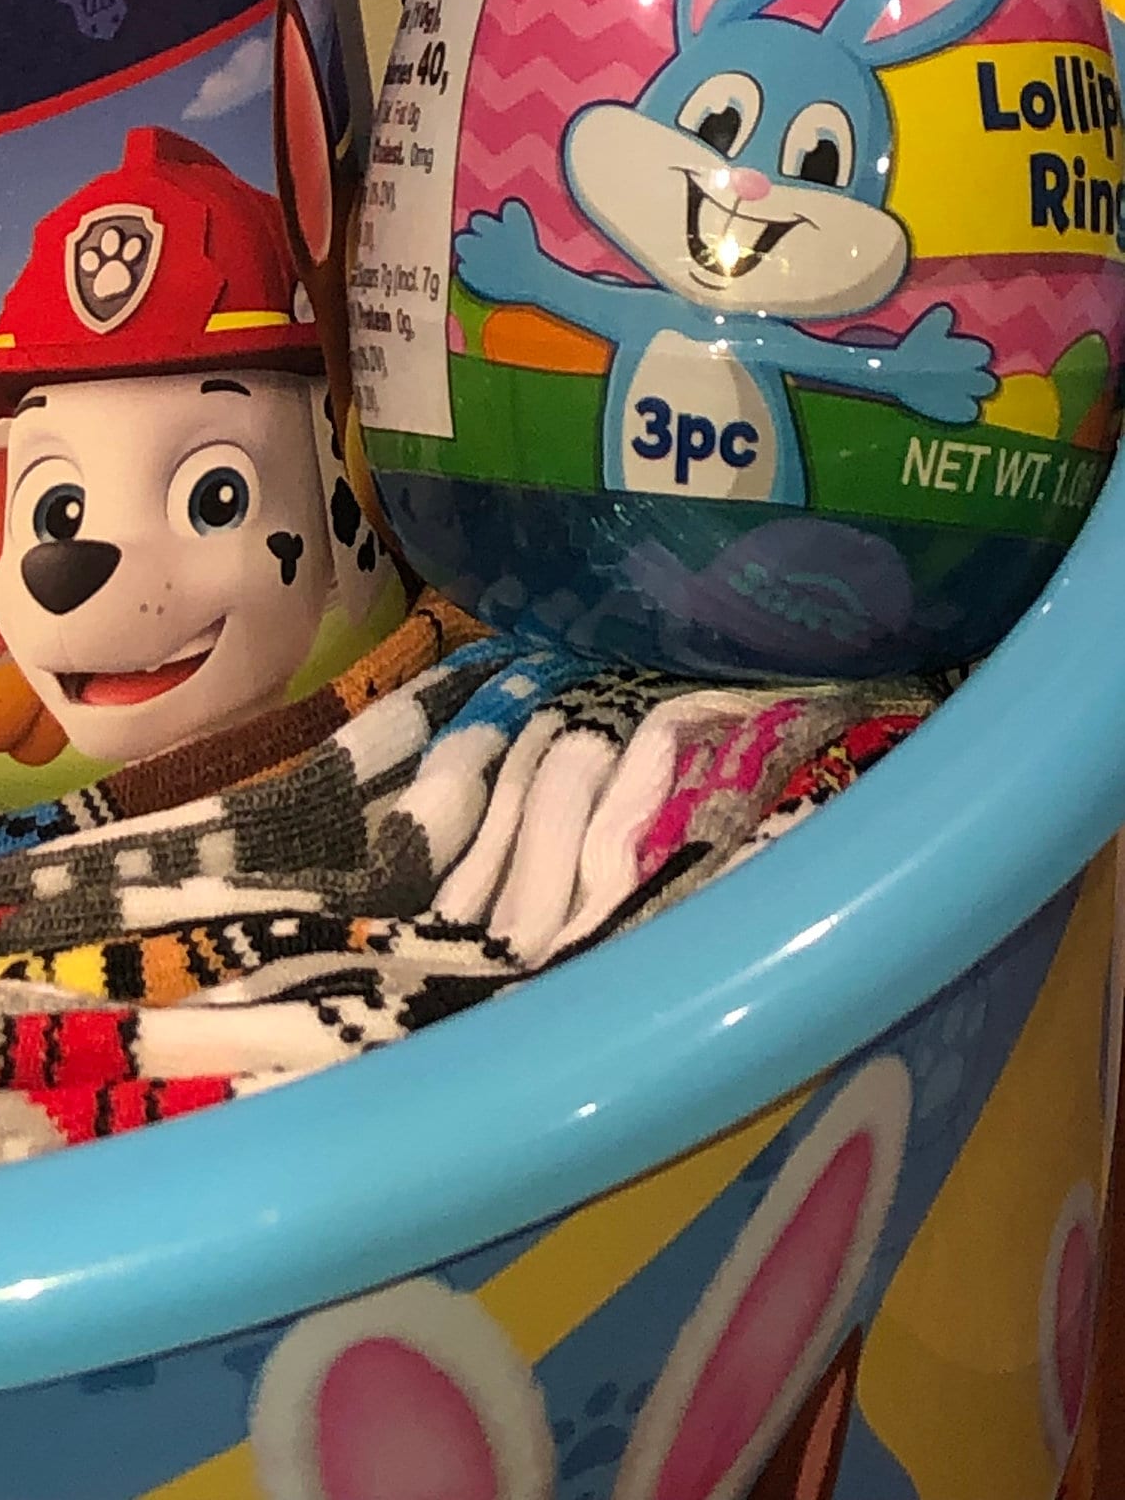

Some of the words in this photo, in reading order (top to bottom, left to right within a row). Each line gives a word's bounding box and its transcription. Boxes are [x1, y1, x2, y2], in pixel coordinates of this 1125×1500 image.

[417, 41, 449, 96] 40,
[423, 266, 441, 301] 7g
[632, 396, 759, 485] 3pc
[902, 436, 992, 493] NET
[994, 448, 1052, 501] WT.
